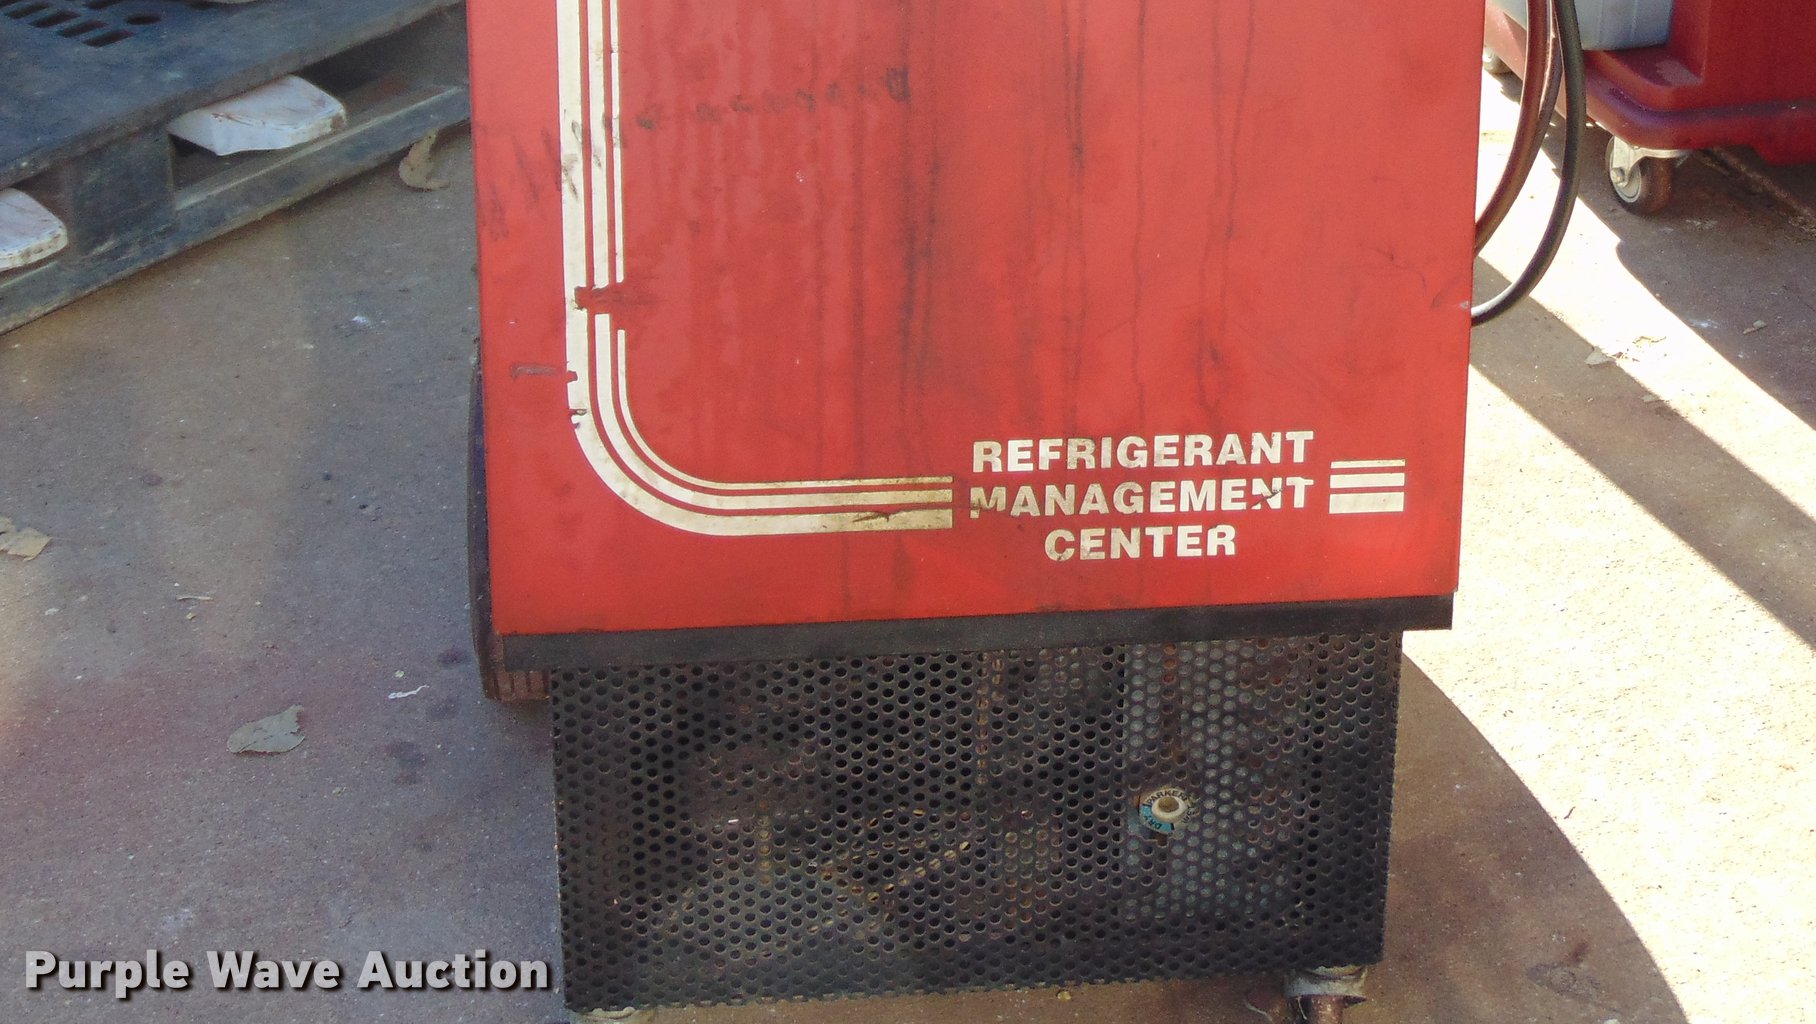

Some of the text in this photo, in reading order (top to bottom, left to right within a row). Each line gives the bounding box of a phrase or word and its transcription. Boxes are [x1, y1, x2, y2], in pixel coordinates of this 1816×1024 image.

[972, 430, 1314, 473] REFRIGERANT
[969, 477, 1314, 518] MANAGEMENT
[1044, 524, 1236, 561] CENTER
[1147, 789, 1187, 804] PARKER
